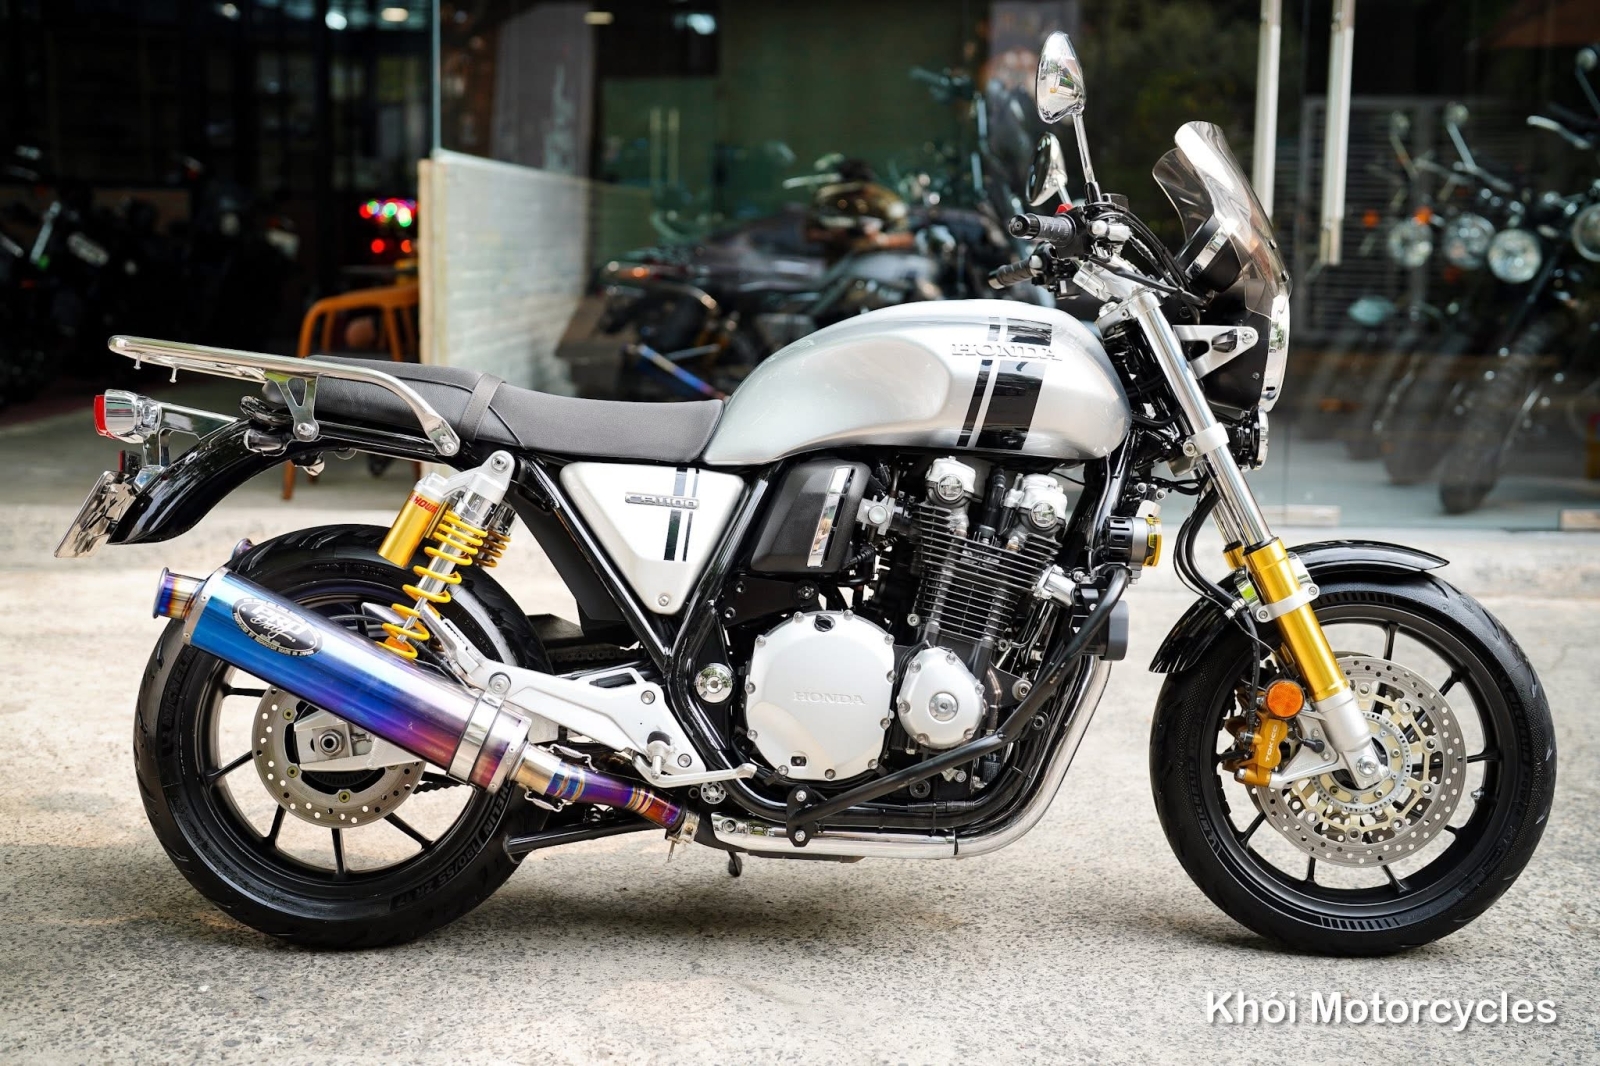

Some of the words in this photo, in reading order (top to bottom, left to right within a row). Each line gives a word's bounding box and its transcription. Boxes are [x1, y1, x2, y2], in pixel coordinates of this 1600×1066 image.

[951, 343, 1063, 361] HONDA
[793, 690, 867, 706] HONDA
[1264, 724, 1278, 762] TOKICO
[483, 779, 512, 836] HELIN
[438, 841, 481, 885] 180/55
